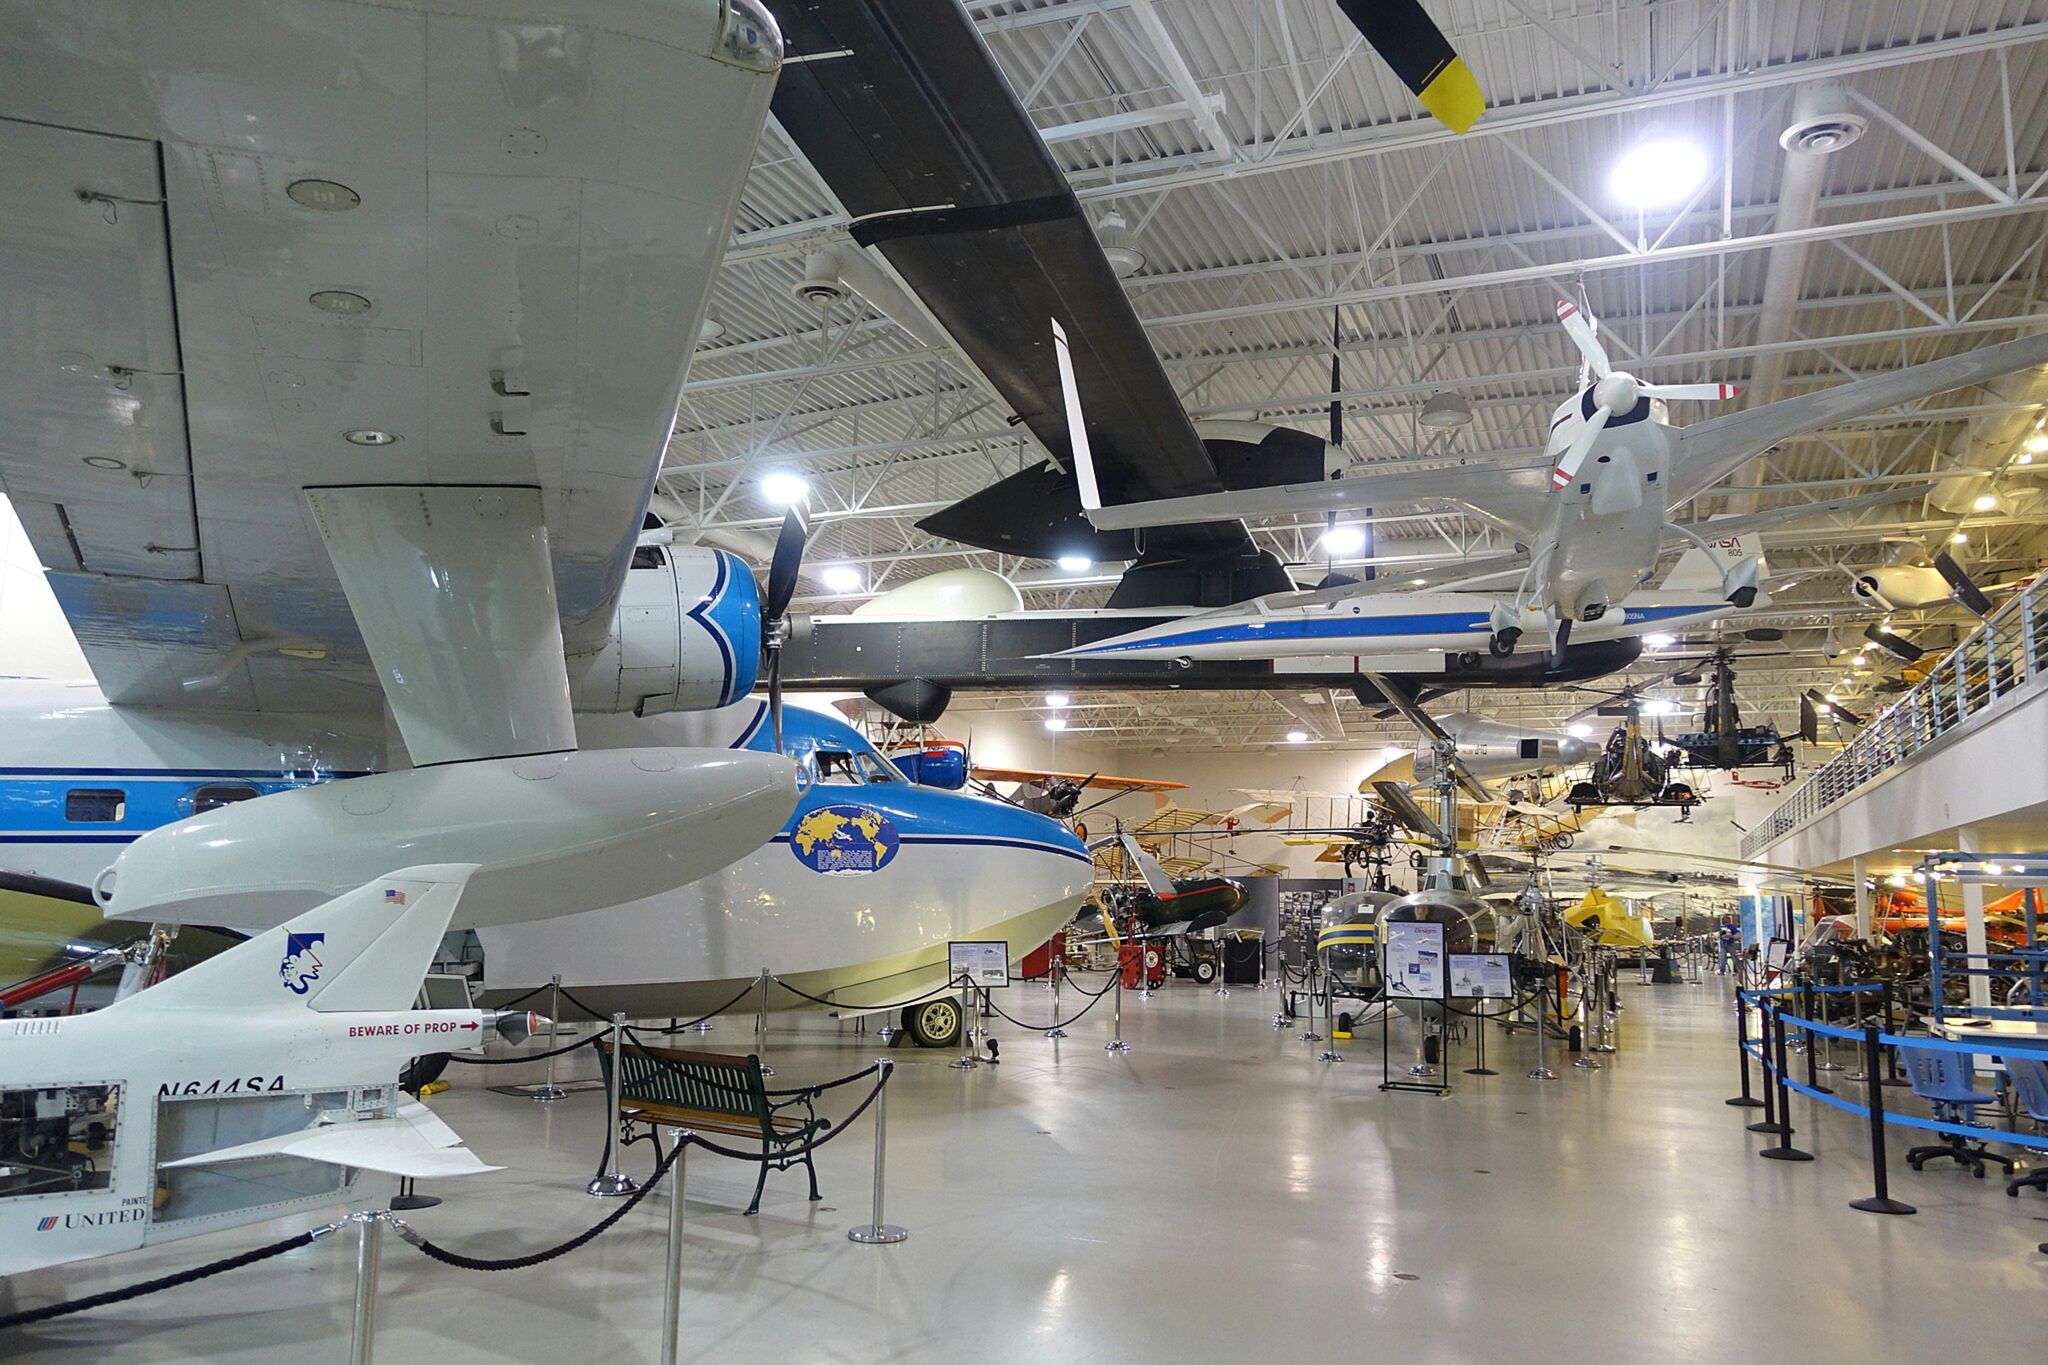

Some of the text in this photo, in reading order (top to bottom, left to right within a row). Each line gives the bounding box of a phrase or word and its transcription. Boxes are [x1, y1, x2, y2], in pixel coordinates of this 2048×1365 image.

[1727, 548, 1743, 557] 805
[349, 1021, 457, 1038] BEWARE OF PROP
[158, 1074, 285, 1096] N644SA
[65, 1207, 145, 1230] UNITED
